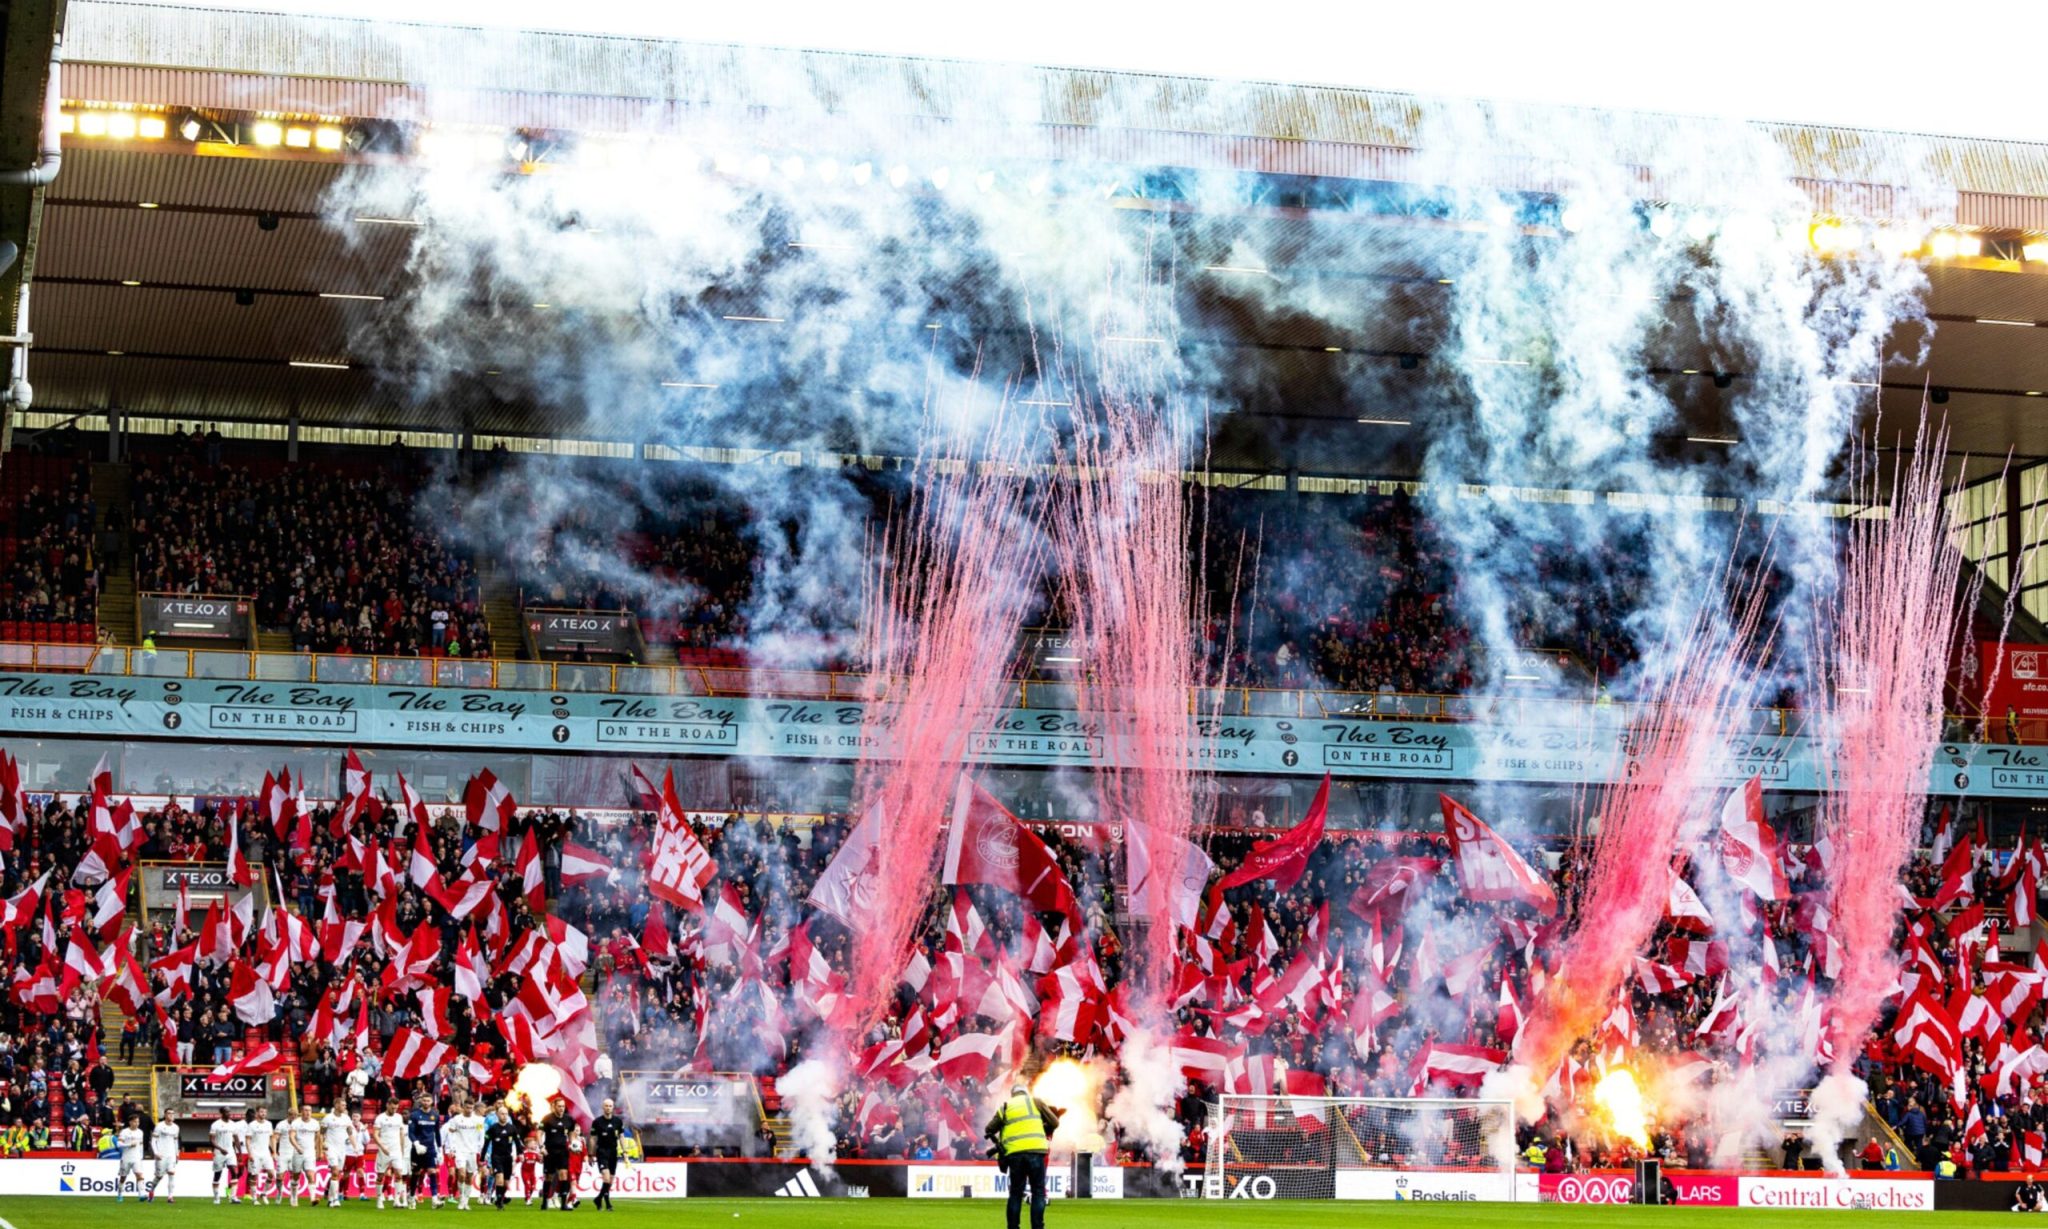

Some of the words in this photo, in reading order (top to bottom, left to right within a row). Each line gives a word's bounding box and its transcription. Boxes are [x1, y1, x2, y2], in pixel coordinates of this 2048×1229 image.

[176, 603, 214, 615] TEXO
[560, 619, 598, 630] TEXO
[0, 677, 54, 697] The
[69, 680, 136, 708] Bay
[215, 685, 274, 704] The
[289, 688, 355, 714] Bay
[388, 691, 448, 711] The
[460, 694, 527, 721] Bay
[11, 708, 46, 719] FISH
[52, 709, 62, 720] &
[67, 709, 114, 721] CHIPS
[219, 712, 242, 723] ON
[252, 713, 287, 724] THE
[296, 714, 346, 726] ROAD
[600, 699, 658, 718] The
[670, 702, 735, 728] Bay
[765, 704, 823, 724] The
[407, 721, 441, 732] FISH
[446, 722, 456, 732] &
[461, 723, 505, 734] CHIPS
[1036, 714, 1099, 738] Bay
[1197, 719, 1257, 746] Bay
[605, 726, 628, 736] ON
[637, 727, 671, 737] THE
[679, 728, 728, 740] ROAD
[1322, 724, 1378, 743] The
[1387, 727, 1449, 753] Bay
[786, 734, 818, 745] FISH
[838, 736, 880, 747] CHIPS
[976, 739, 998, 749] ON
[1006, 739, 1039, 750] THE
[1048, 741, 1093, 752] ROAD
[1331, 750, 1352, 760] ON
[1360, 751, 1391, 762] THE
[1400, 752, 1443, 763] ROAD
[1987, 749, 2041, 766] The
[1497, 759, 1527, 768] FISH
[1531, 760, 1540, 769] &
[1544, 760, 1584, 771] CHIPS
[1737, 765, 1780, 776] ROAD
[1999, 773, 2018, 783] ON
[180, 873, 222, 884] TEXO
[201, 1079, 247, 1090] TEXO
[273, 1078, 286, 1087] 40
[665, 1085, 708, 1096] TEXO
[936, 1174, 991, 1192] FOWLER
[1183, 1175, 1276, 1199] TEXO
[1750, 1185, 1828, 1207] Central
[1836, 1186, 1924, 1207] Coaches
